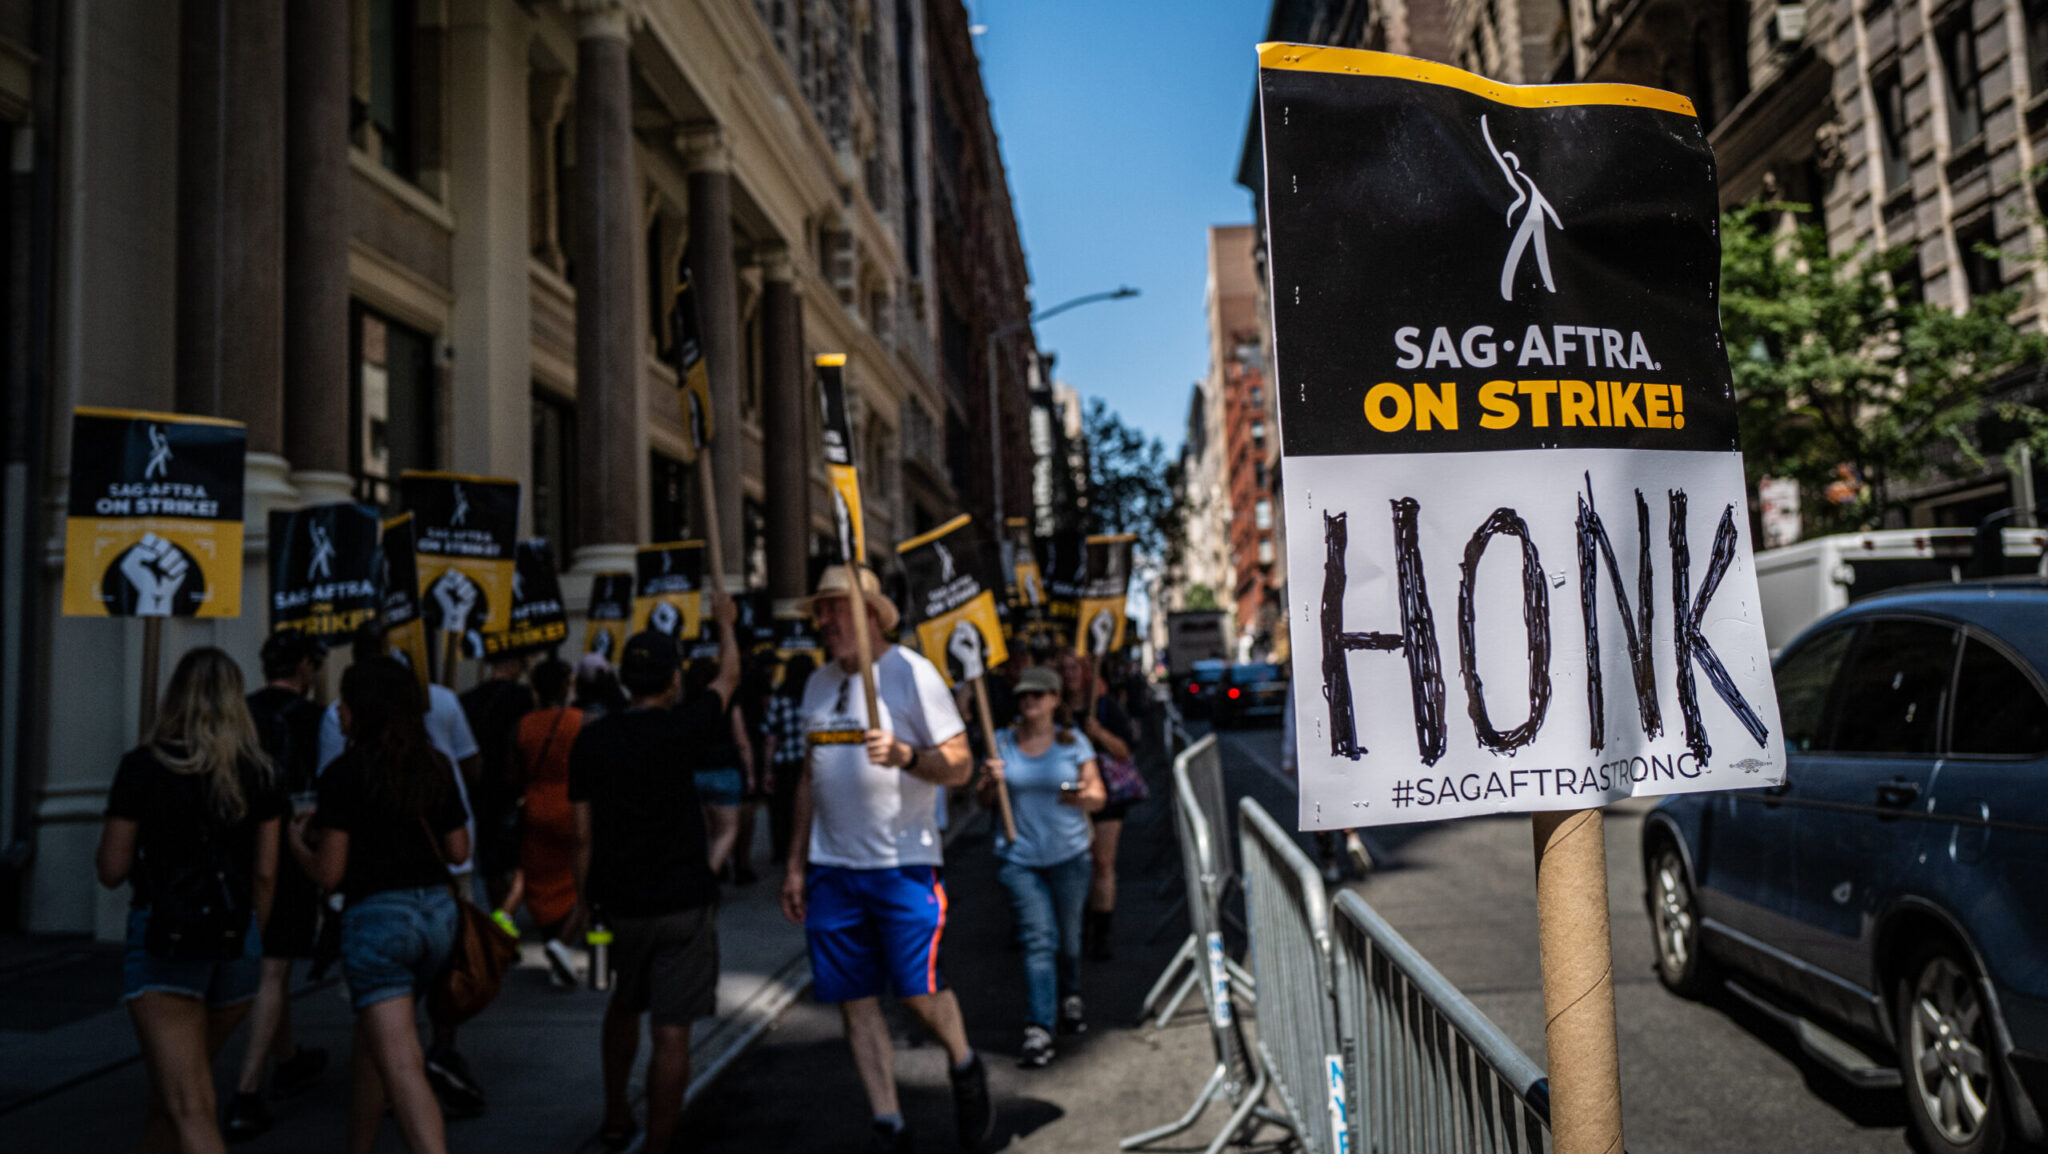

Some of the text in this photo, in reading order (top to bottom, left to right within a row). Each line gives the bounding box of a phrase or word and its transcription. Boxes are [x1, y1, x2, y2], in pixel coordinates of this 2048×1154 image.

[1363, 380, 1685, 432] ON STRIKE!
[95, 497, 219, 517] ON STRIKE!
[1321, 470, 1767, 767] HONK
[1391, 752, 1702, 808] #SAGAFTRASTRONG
